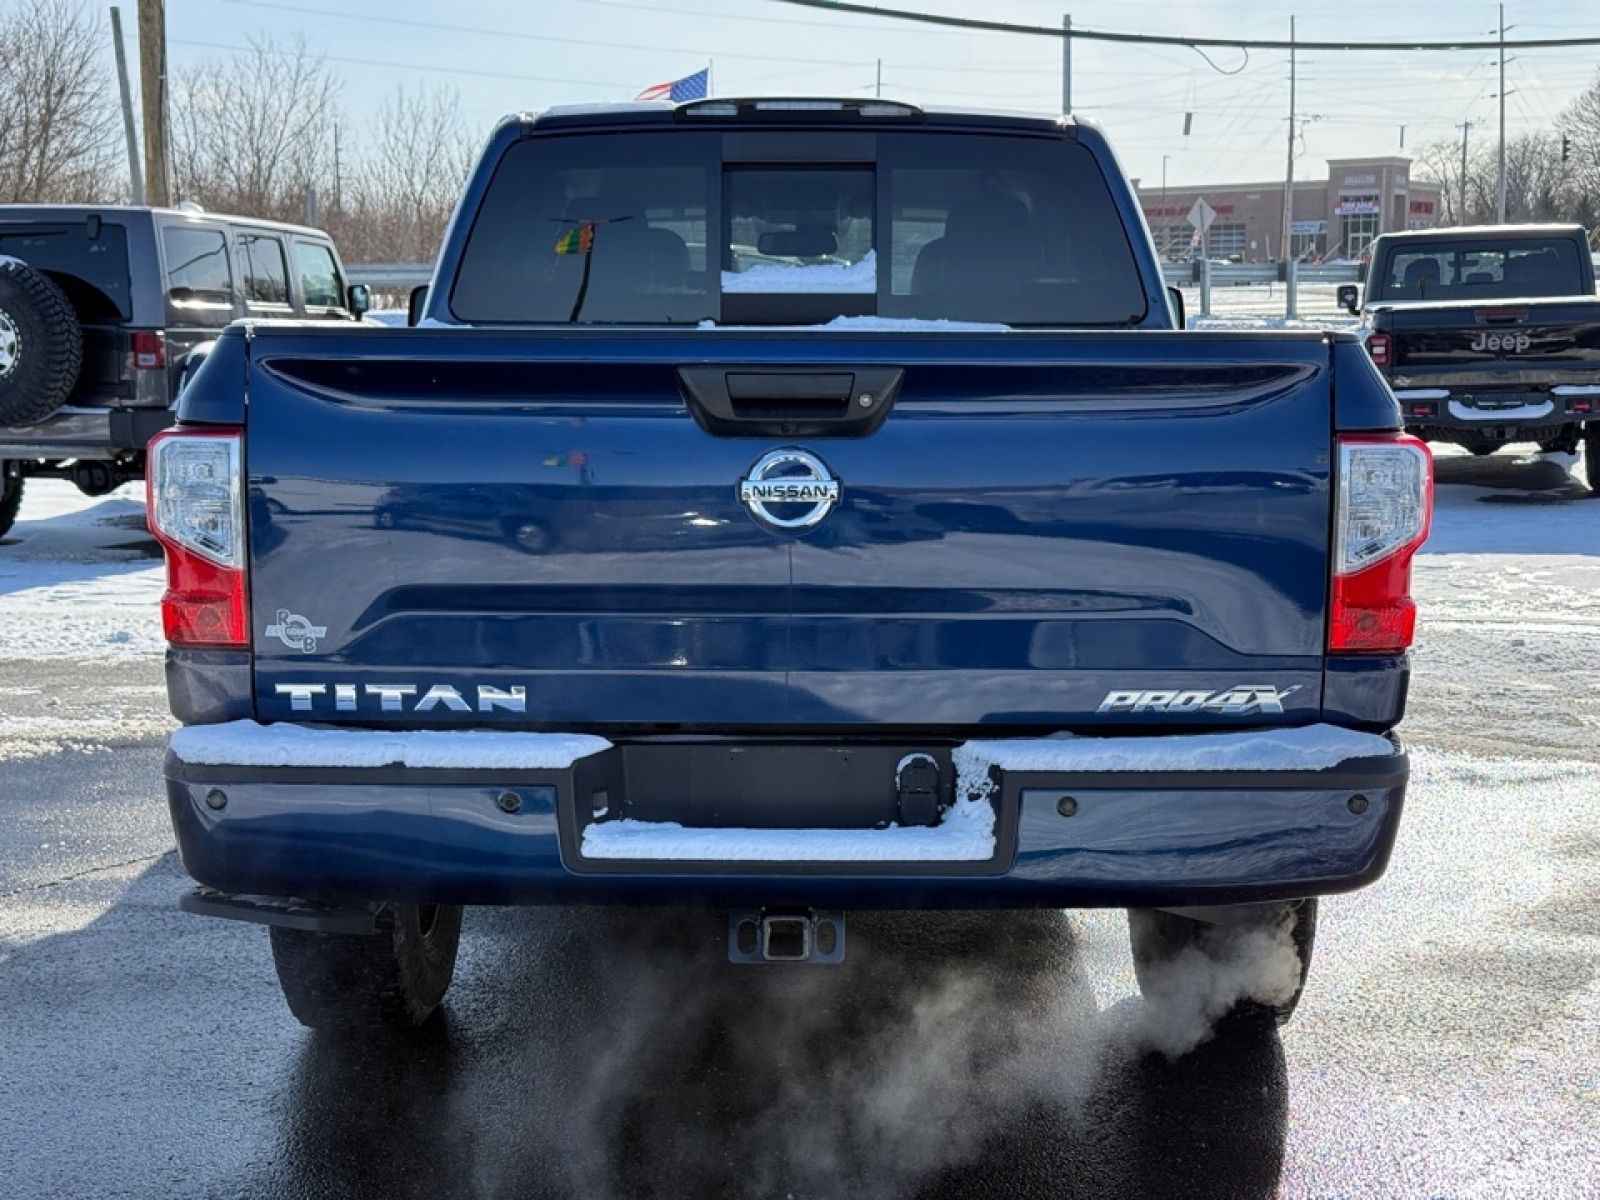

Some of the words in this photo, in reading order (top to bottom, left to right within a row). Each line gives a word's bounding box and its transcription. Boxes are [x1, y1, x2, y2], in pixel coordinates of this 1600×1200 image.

[1470, 332, 1531, 353] Jeep
[752, 484, 828, 498] NISSAN
[277, 609, 291, 626] R
[274, 683, 526, 712] TITAN
